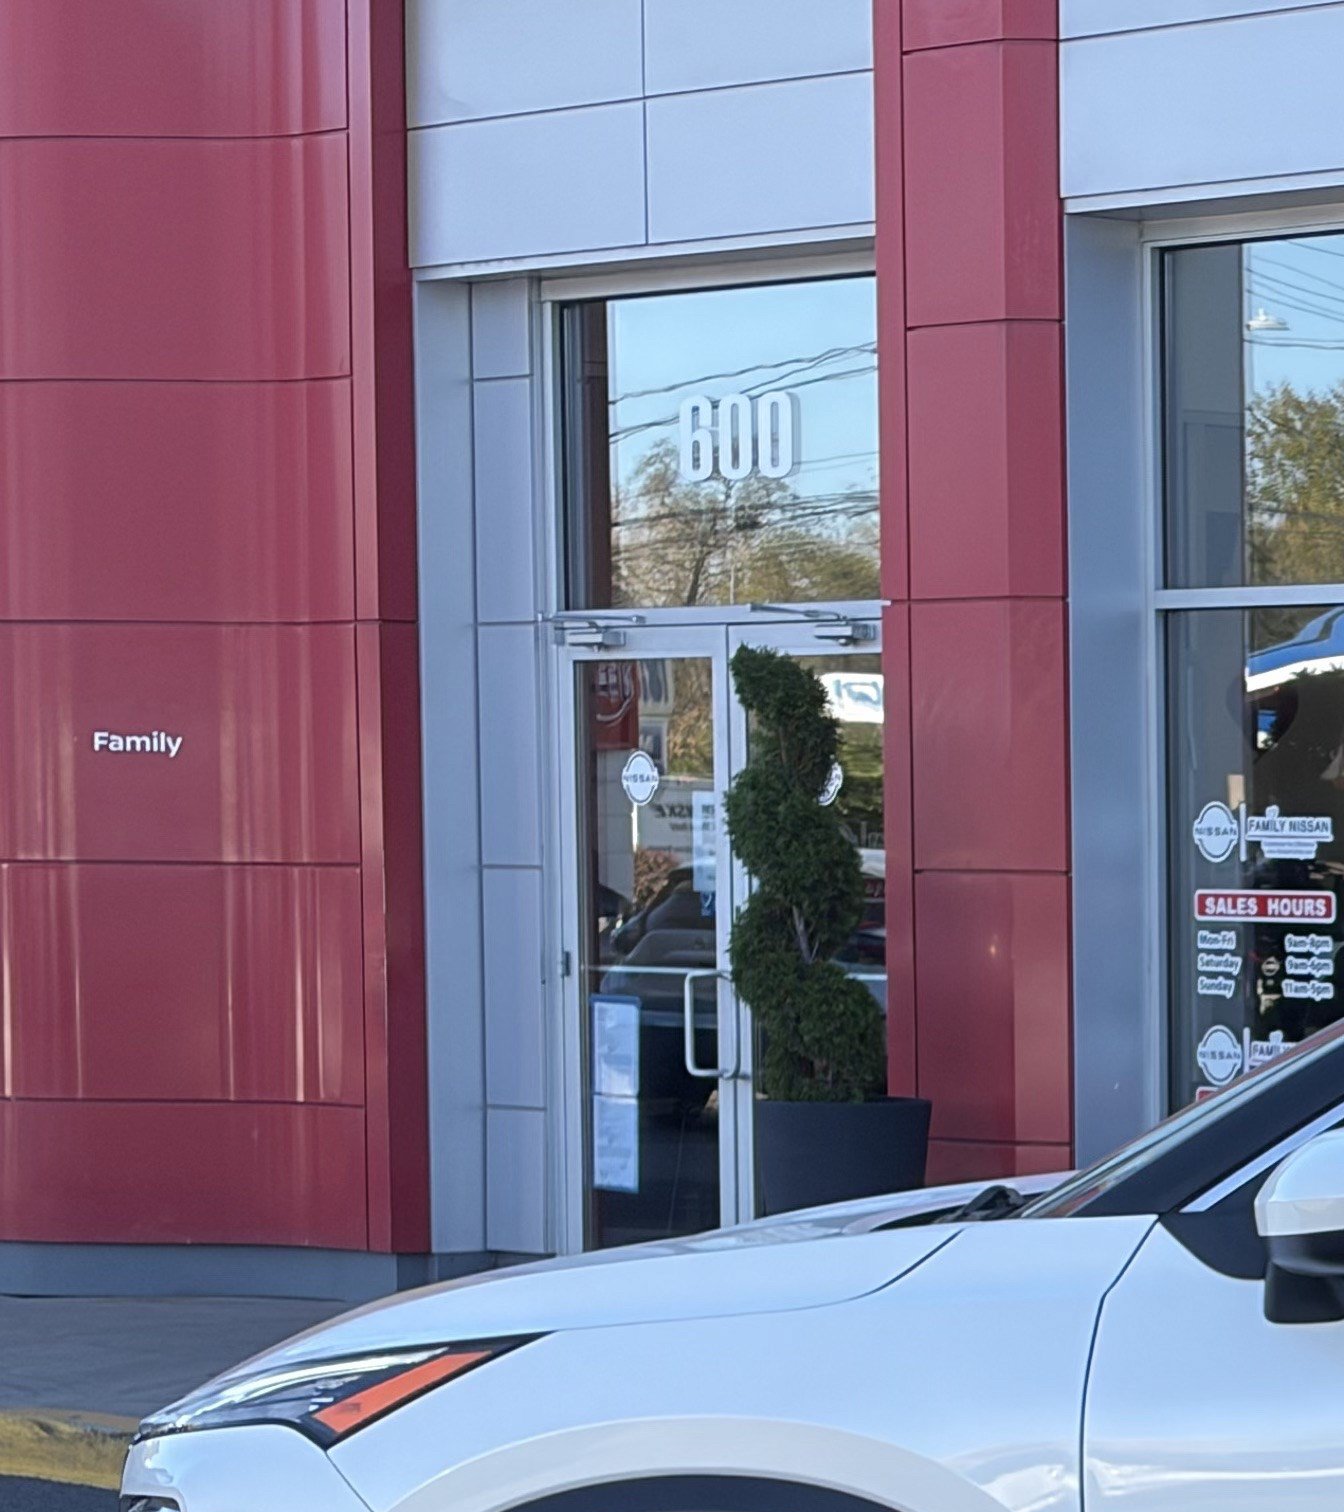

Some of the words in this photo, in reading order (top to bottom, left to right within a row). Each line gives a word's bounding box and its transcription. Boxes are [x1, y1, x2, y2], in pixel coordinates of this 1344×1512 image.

[679, 391, 793, 482] 600
[93, 730, 183, 758] Family
[1195, 827, 1237, 837] NISSAN
[1248, 820, 1285, 832] FAMILY
[1289, 820, 1329, 833] NISSAN
[1204, 897, 1258, 915] SALES
[1267, 898, 1327, 916] HOURS
[1199, 955, 1240, 972] Saturday
[1199, 978, 1233, 995] Sunday
[1199, 1050, 1240, 1060] NISSAN
